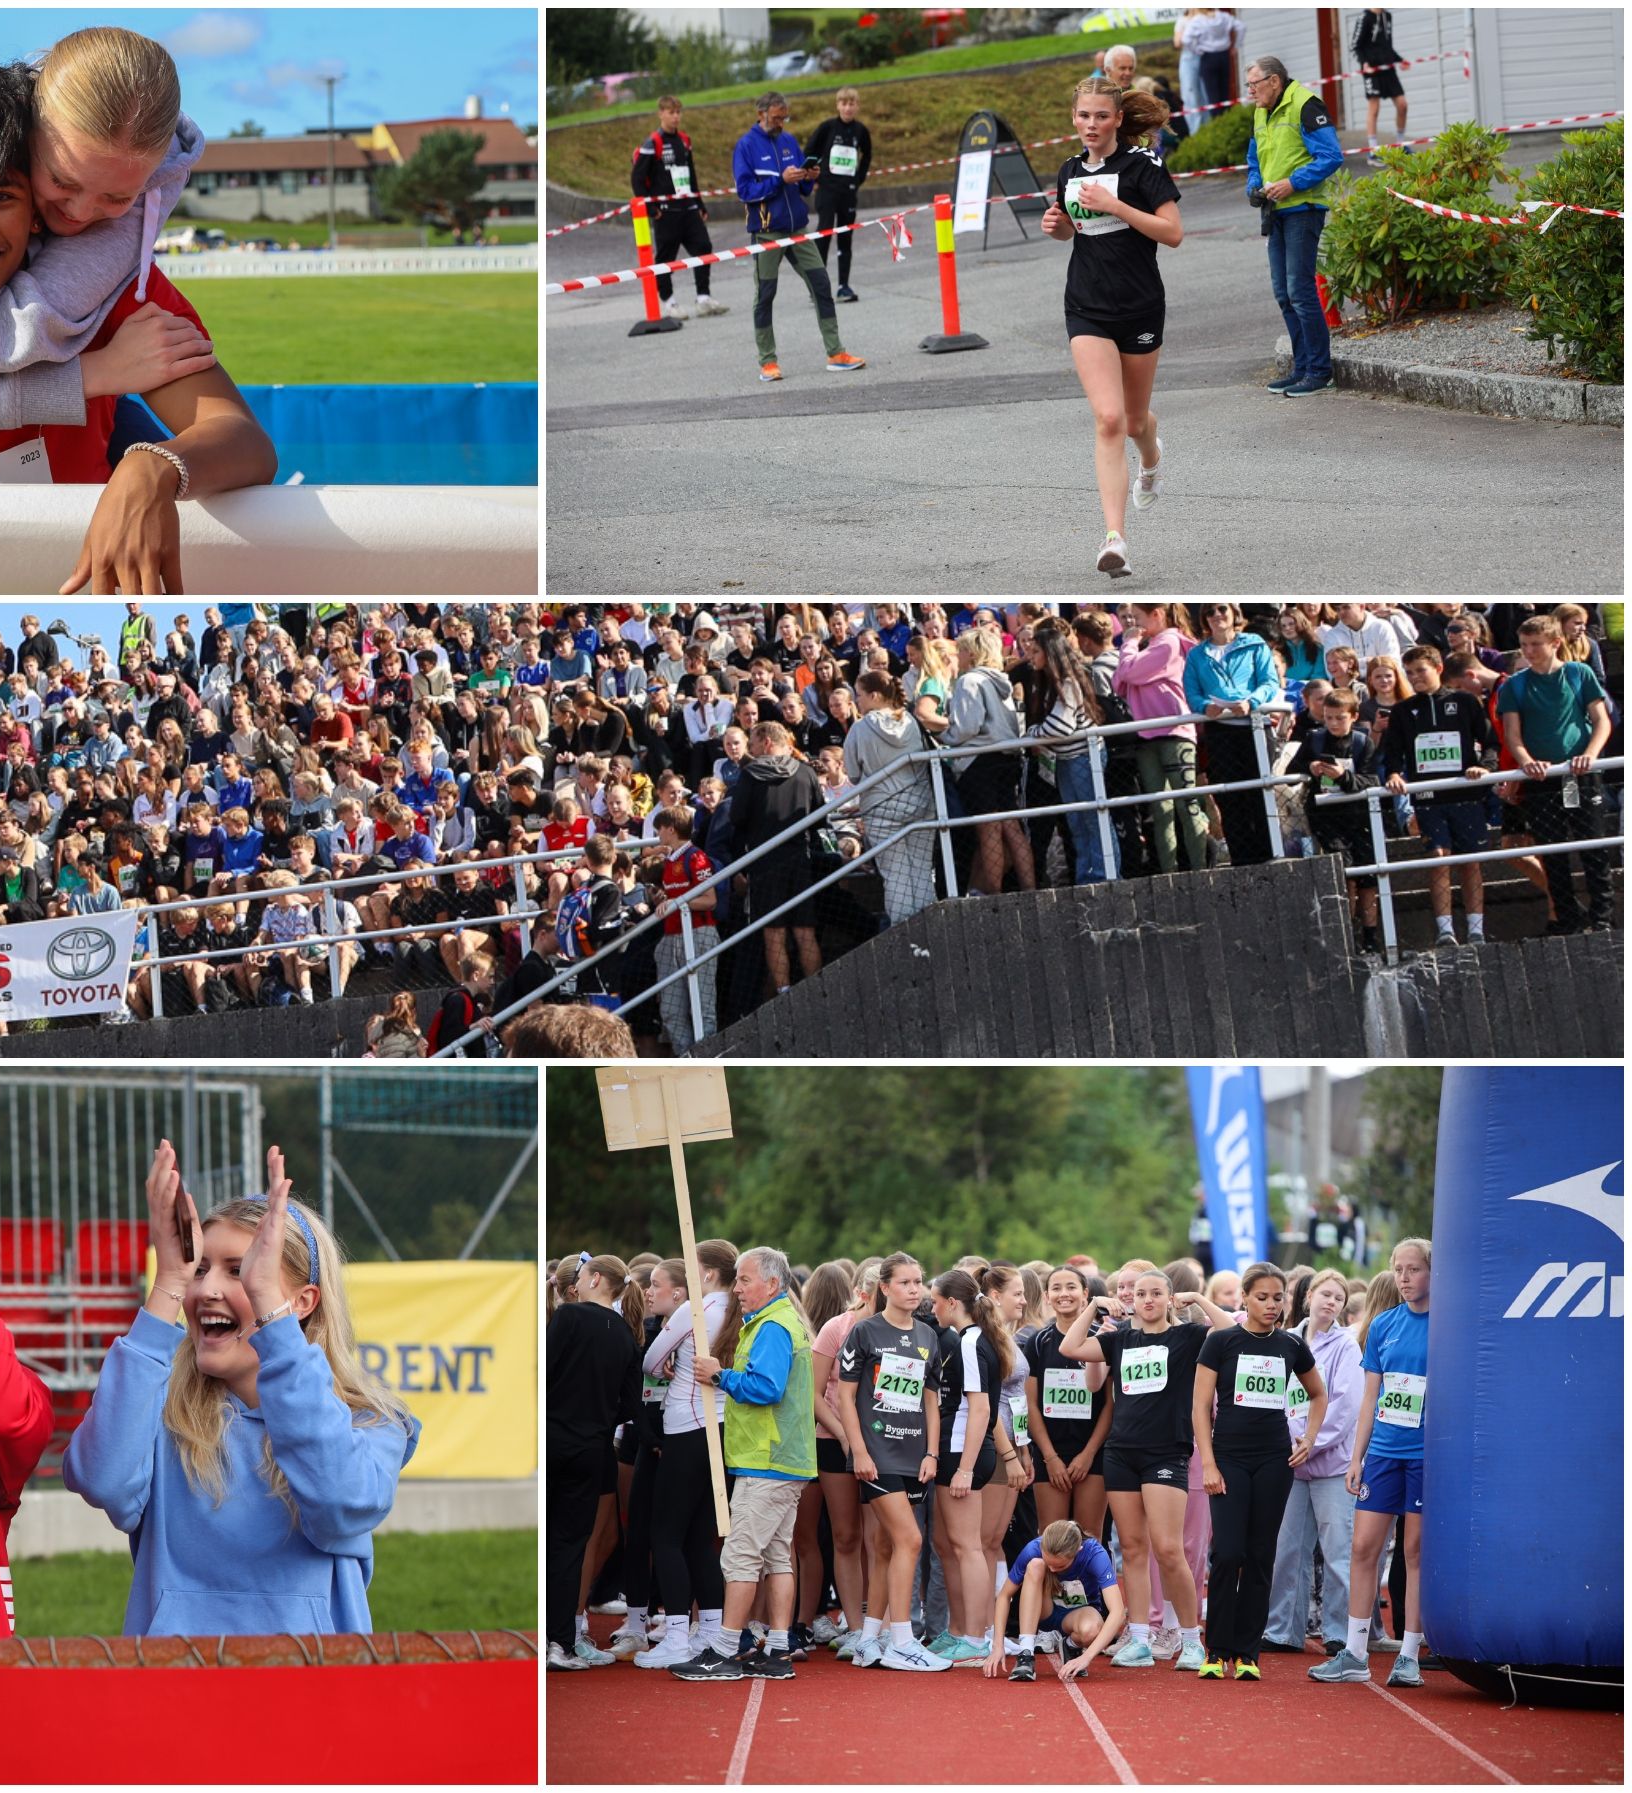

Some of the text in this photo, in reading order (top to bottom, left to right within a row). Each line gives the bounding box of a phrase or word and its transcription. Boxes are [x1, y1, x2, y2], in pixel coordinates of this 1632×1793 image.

[20, 449, 42, 465] 2023
[1421, 748, 1455, 761] 1051
[40, 983, 122, 1006] TOYOTA
[1125, 1362, 1162, 1381] 1213
[880, 1375, 919, 1396] 2173
[1246, 1376, 1276, 1393] 603
[1049, 1388, 1086, 1404] 1200
[1385, 1392, 1412, 1411] 594
